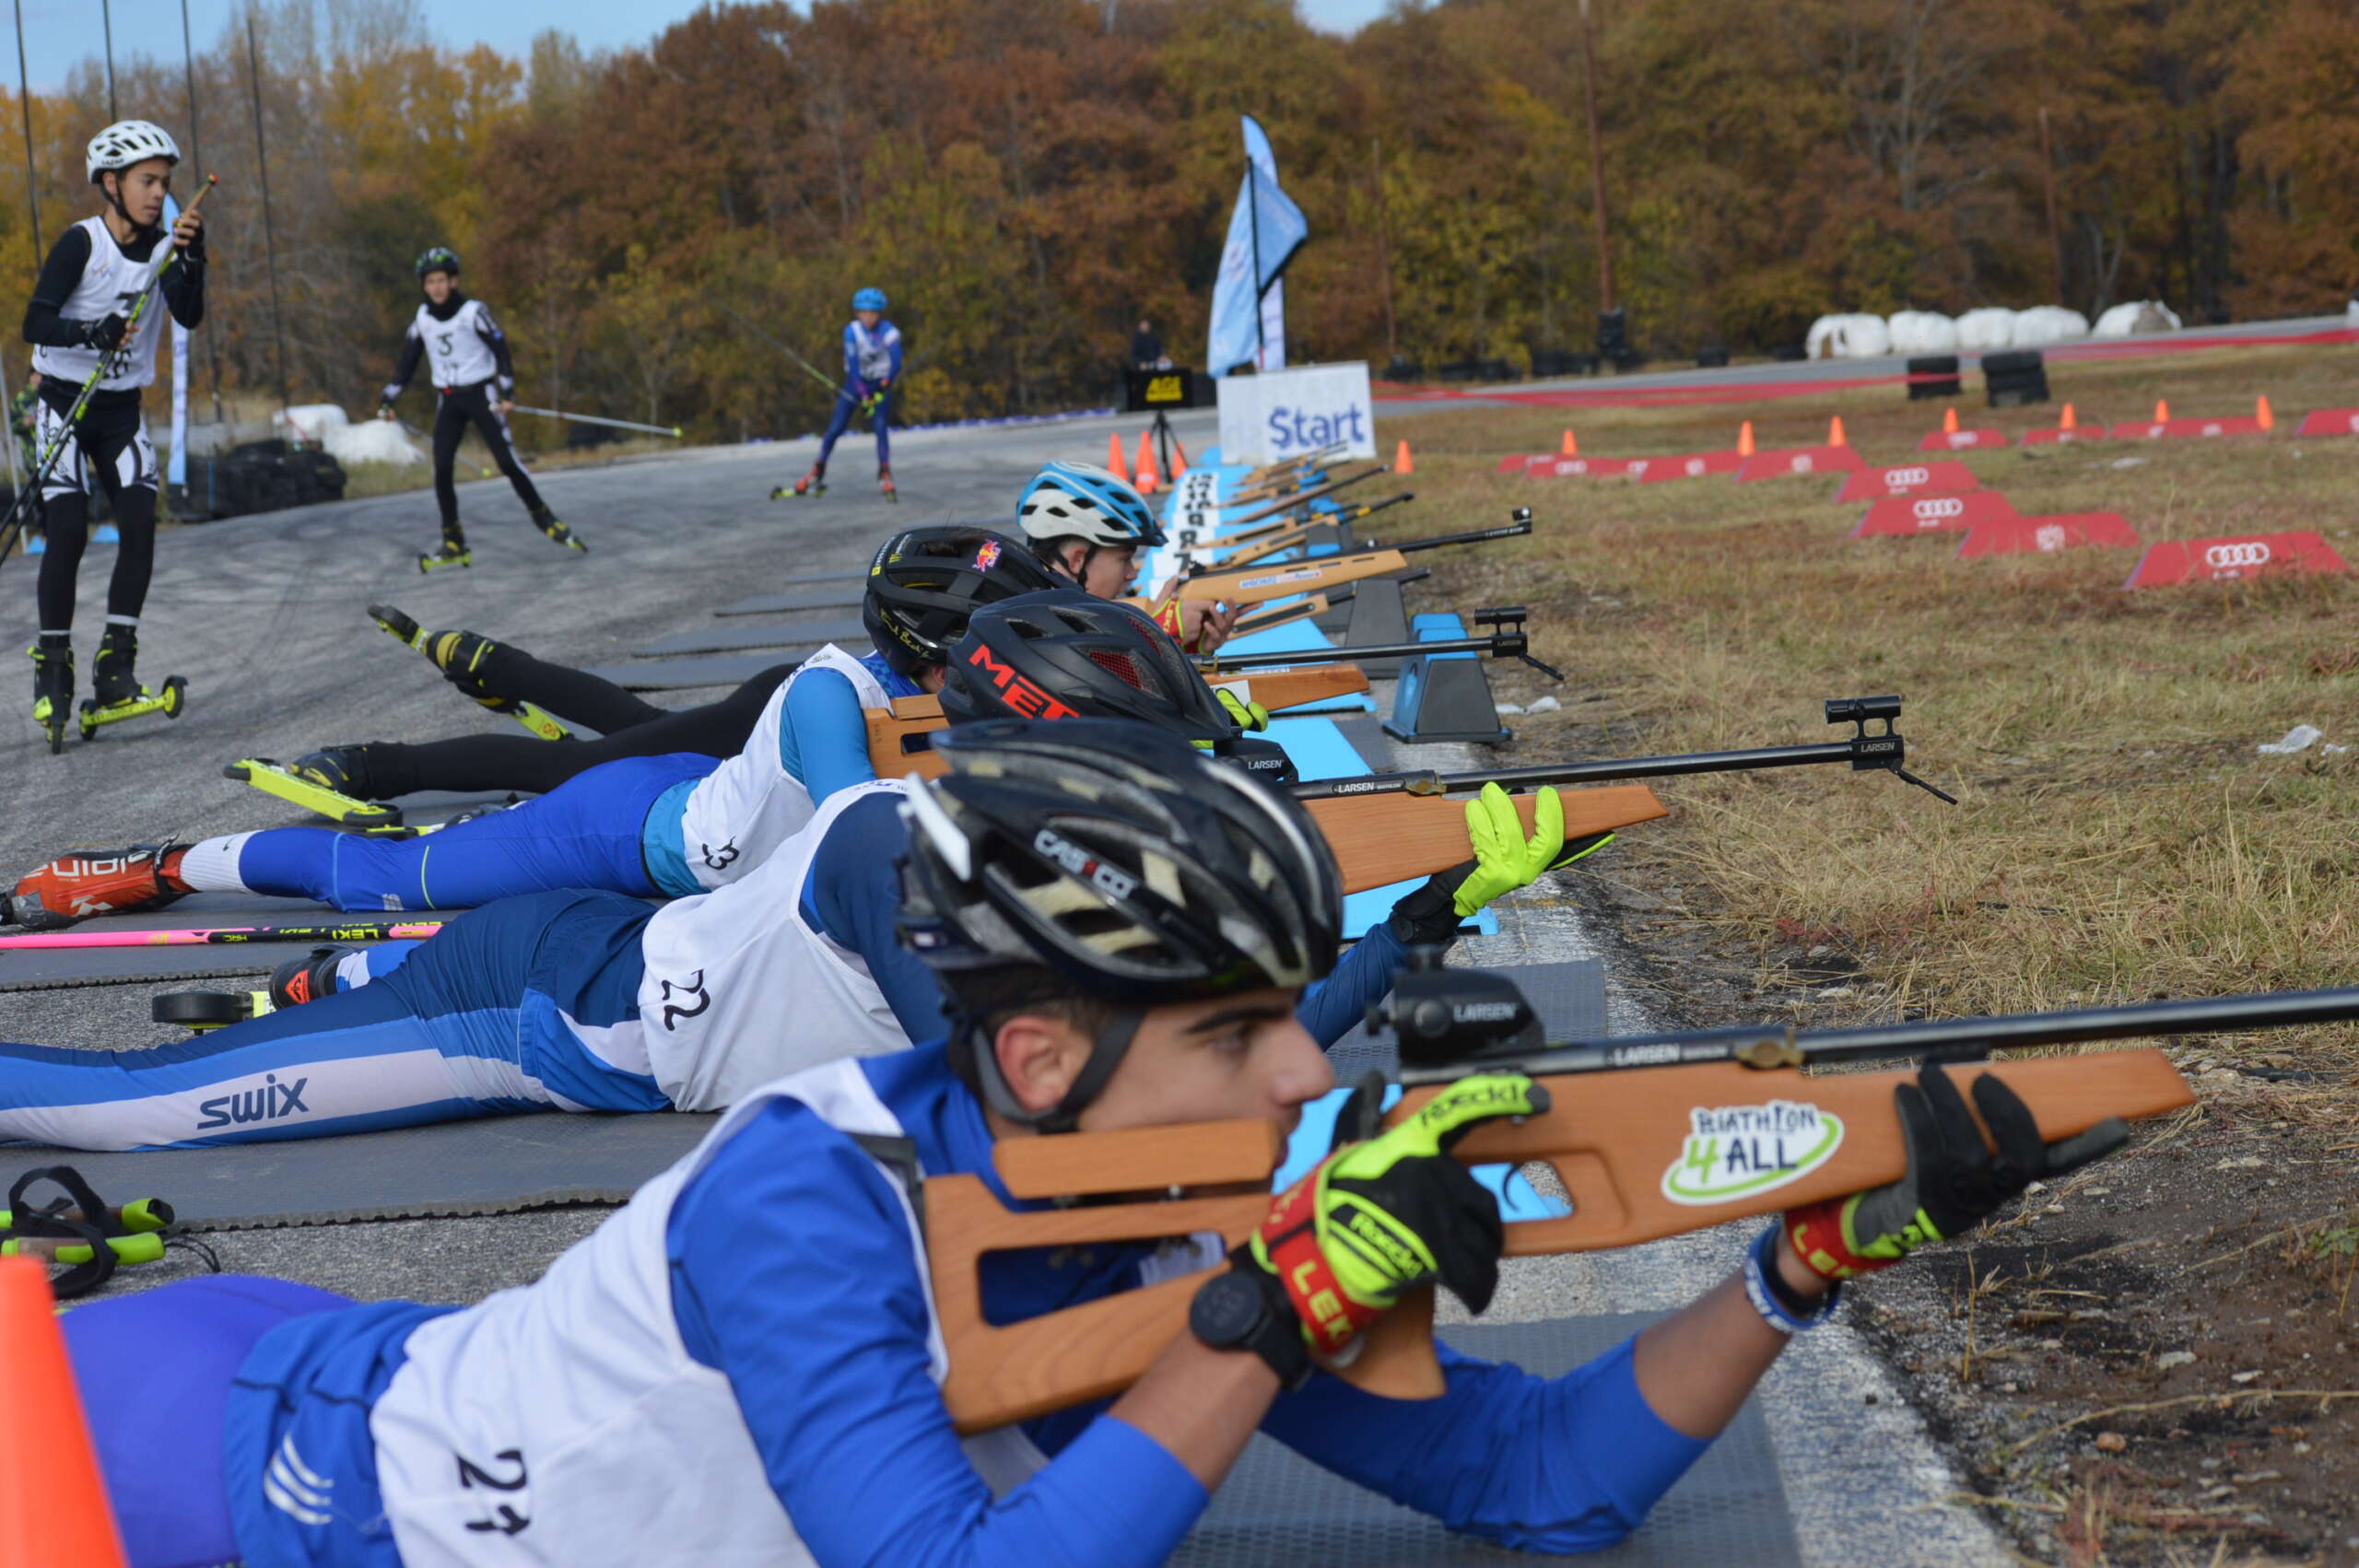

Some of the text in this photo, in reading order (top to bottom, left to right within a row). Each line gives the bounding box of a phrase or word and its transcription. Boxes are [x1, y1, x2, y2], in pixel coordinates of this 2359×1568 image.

[1269, 402, 1364, 449] Start
[968, 644, 1082, 720] MET
[1860, 743, 1895, 753] LARSEN
[1248, 760, 1282, 770] LARSEN
[1338, 782, 1375, 793] LARSEN
[332, 929, 380, 940] LEKI
[661, 968, 711, 1032] 22
[1453, 1002, 1516, 1024] LARSEN
[1614, 1043, 1681, 1067] LARSEN
[1685, 1137, 1799, 1185] 4 ALL
